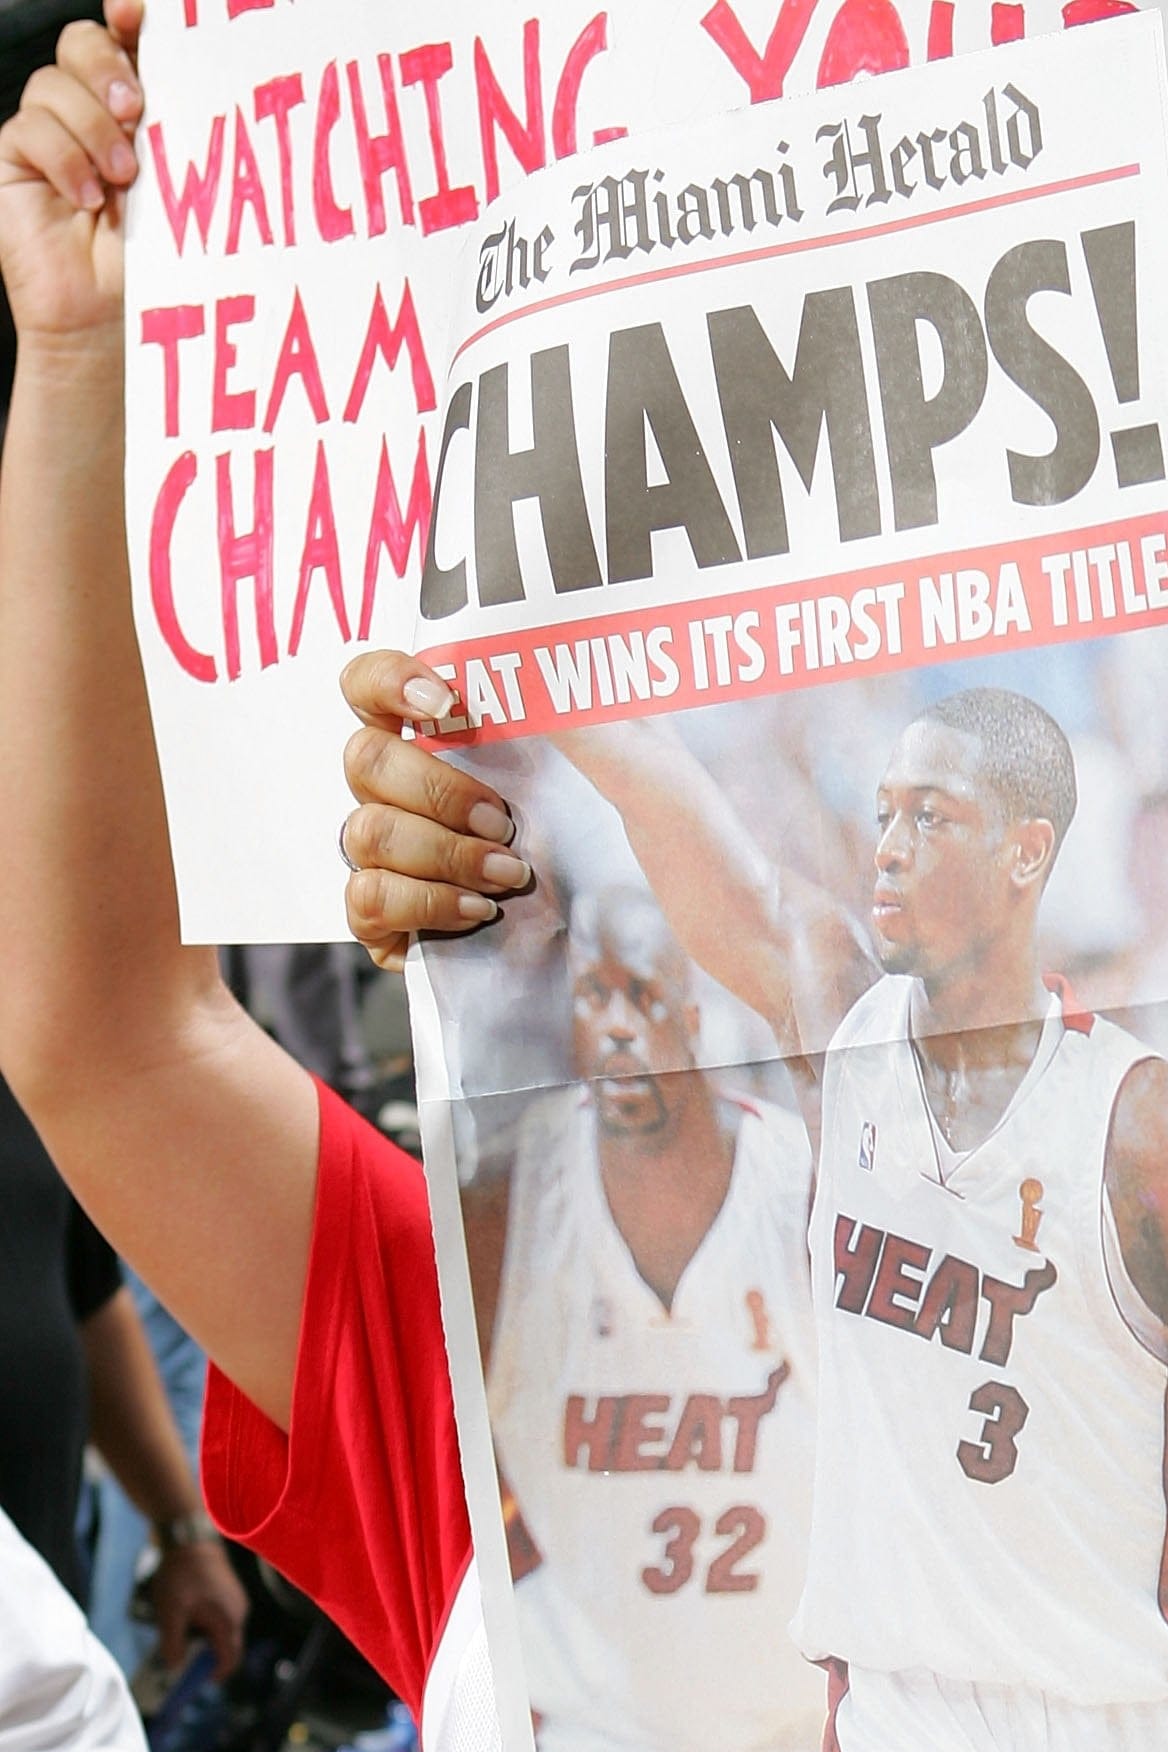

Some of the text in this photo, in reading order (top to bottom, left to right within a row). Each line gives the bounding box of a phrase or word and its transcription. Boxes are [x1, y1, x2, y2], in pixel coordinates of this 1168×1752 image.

[476, 86, 1043, 313] The Miami Herald
[141, 277, 437, 438] TEAM
[420, 220, 1165, 620] CHAMPS!
[401, 652, 527, 741] EAT
[534, 625, 680, 714] WINS
[688, 610, 765, 690] ITS
[775, 582, 905, 675] FIRST
[919, 561, 1032, 649] NBA
[832, 1212, 1058, 1368] HEAT
[563, 1359, 791, 1473] HEAT
[957, 1380, 1030, 1485] 3
[641, 1504, 767, 1595] 32
